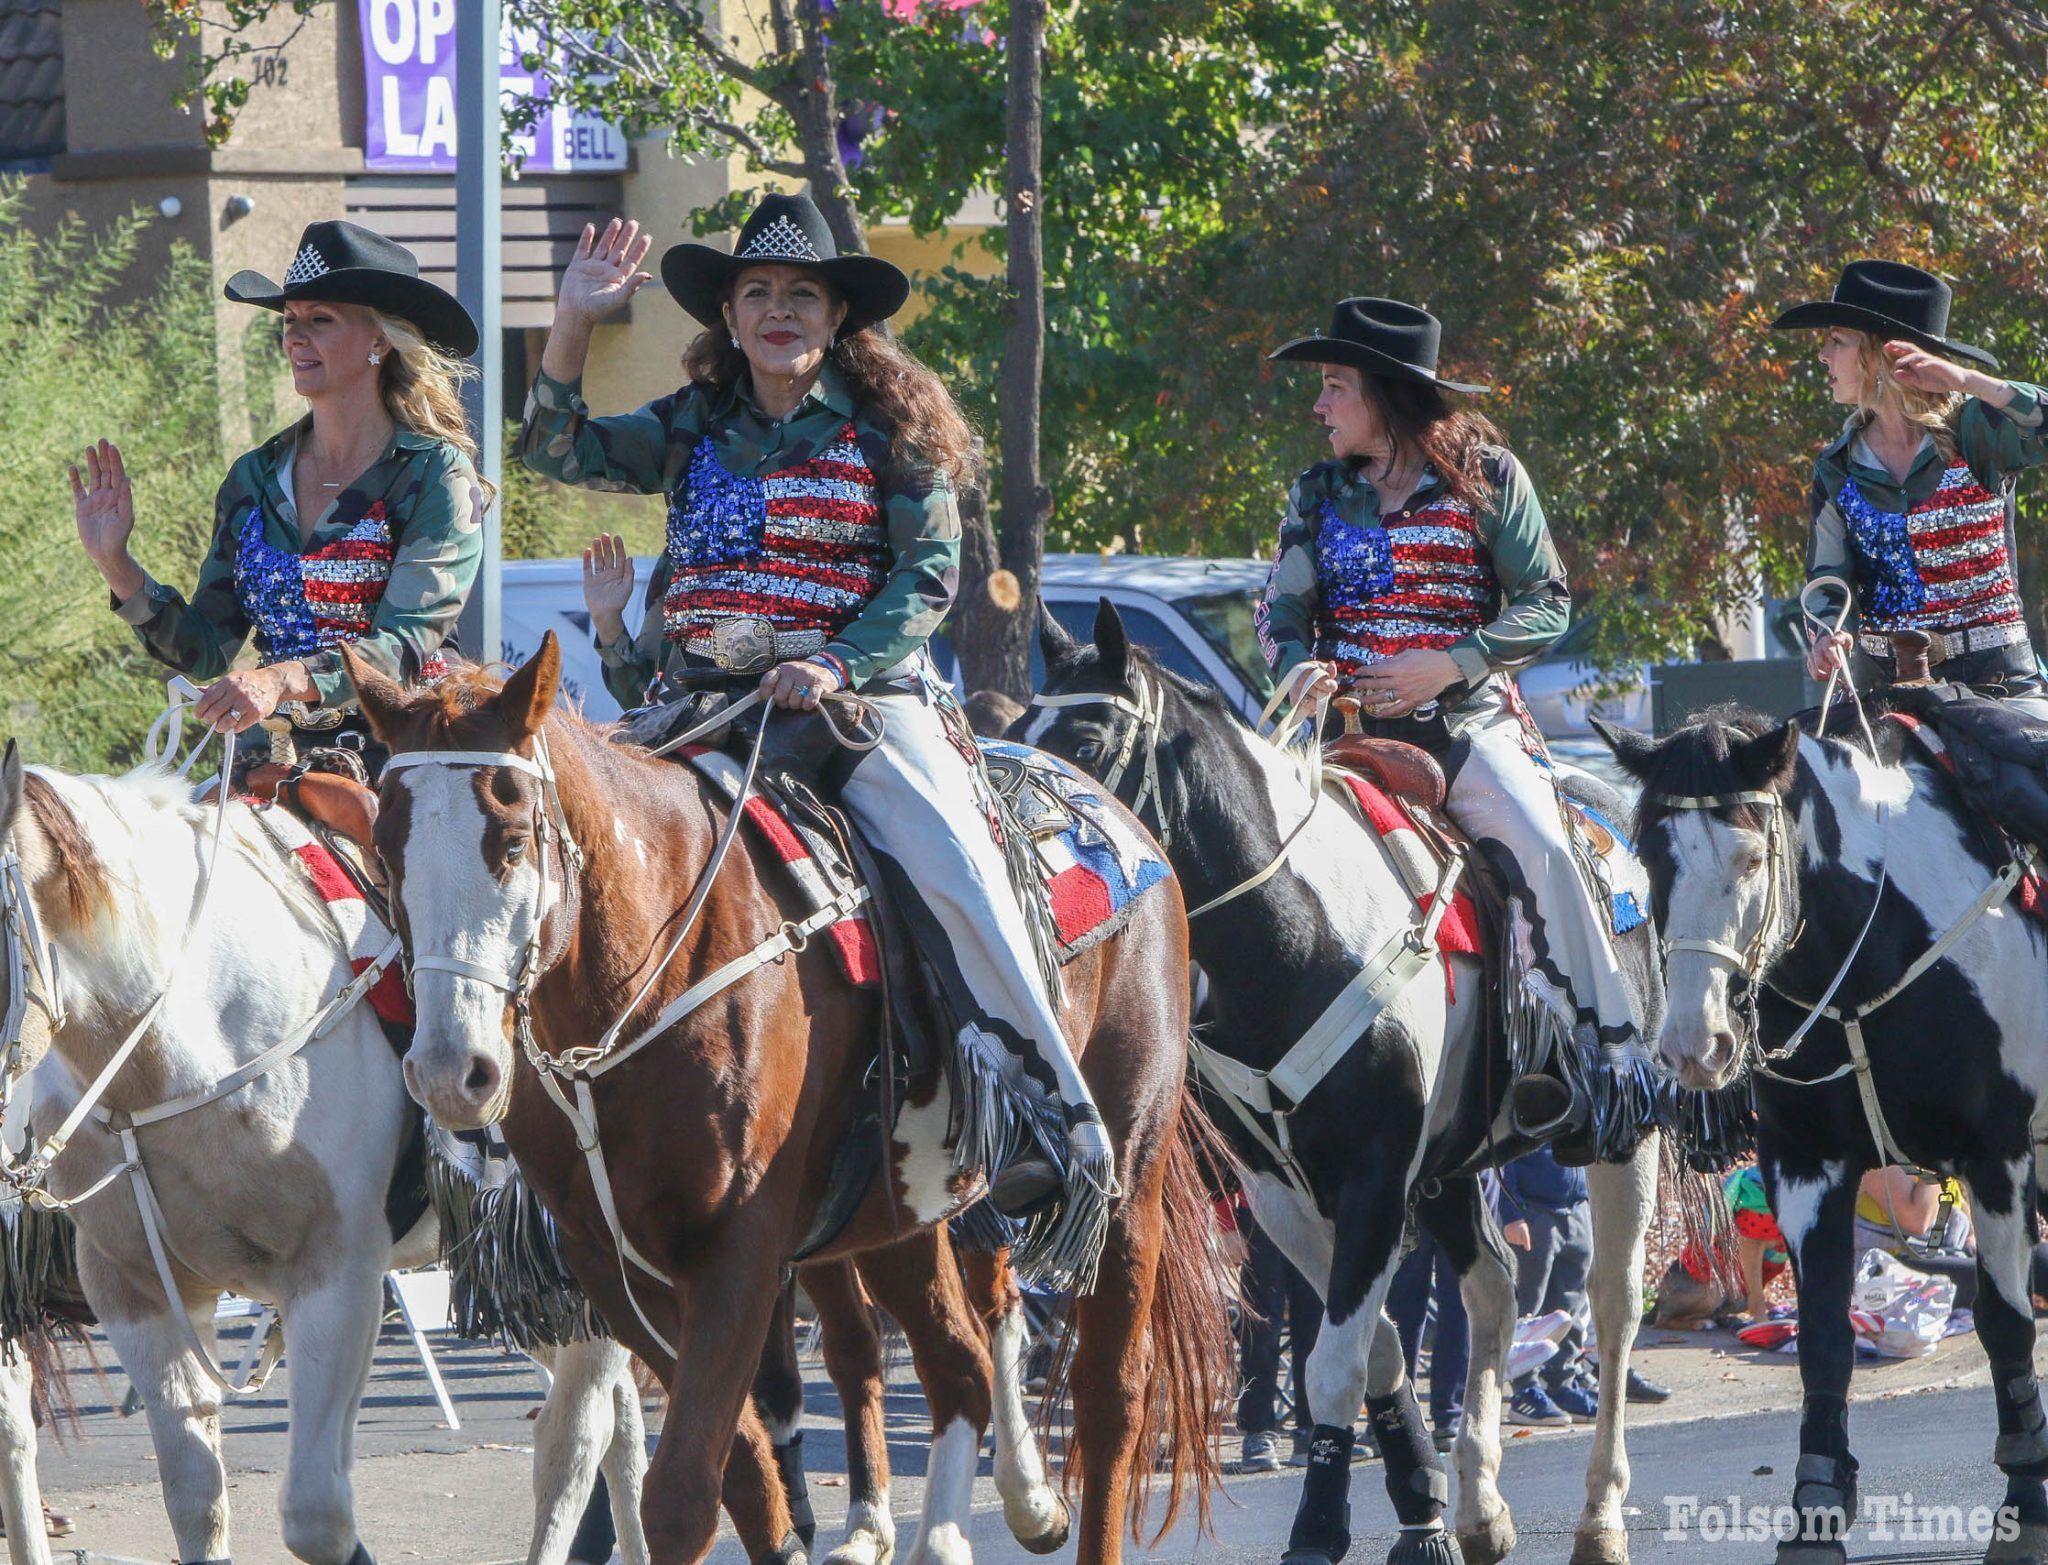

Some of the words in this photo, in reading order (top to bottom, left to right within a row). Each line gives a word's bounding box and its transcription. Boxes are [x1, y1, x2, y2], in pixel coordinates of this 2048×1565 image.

[369, 0, 541, 65] OPN
[381, 75, 537, 157] LAE
[563, 127, 616, 161] BELL
